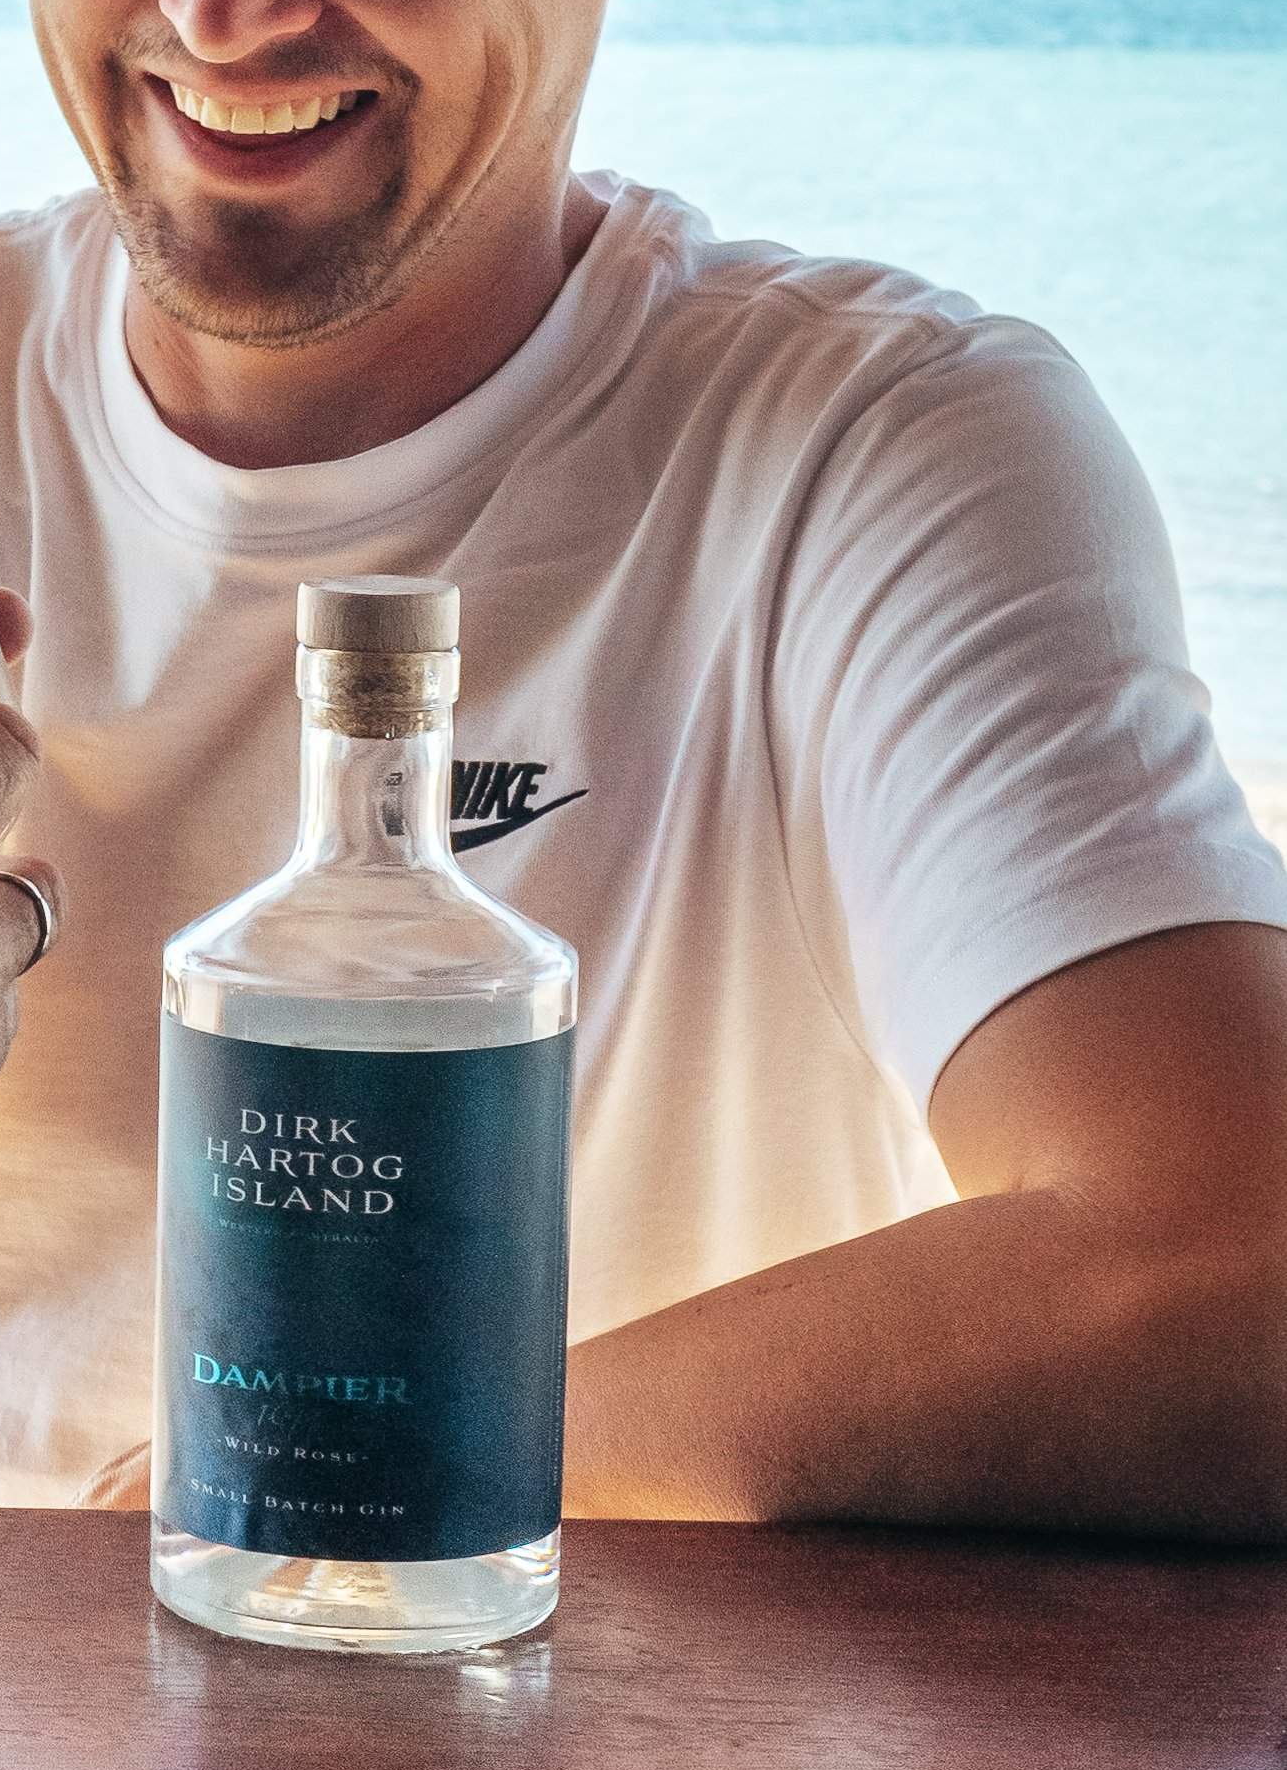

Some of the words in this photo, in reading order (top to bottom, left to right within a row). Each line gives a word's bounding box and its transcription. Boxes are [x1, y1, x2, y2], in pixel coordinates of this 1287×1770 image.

[451, 760, 548, 820] NIKE
[239, 1108, 359, 1145] DIRK
[206, 1137, 405, 1181] HARTOG
[211, 1172, 396, 1216] ISLAND
[192, 1351, 415, 1406] DAMPIER
[190, 1478, 253, 1505] SMALL
[264, 1495, 344, 1515] BATCH
[359, 1503, 405, 1516] GIN
